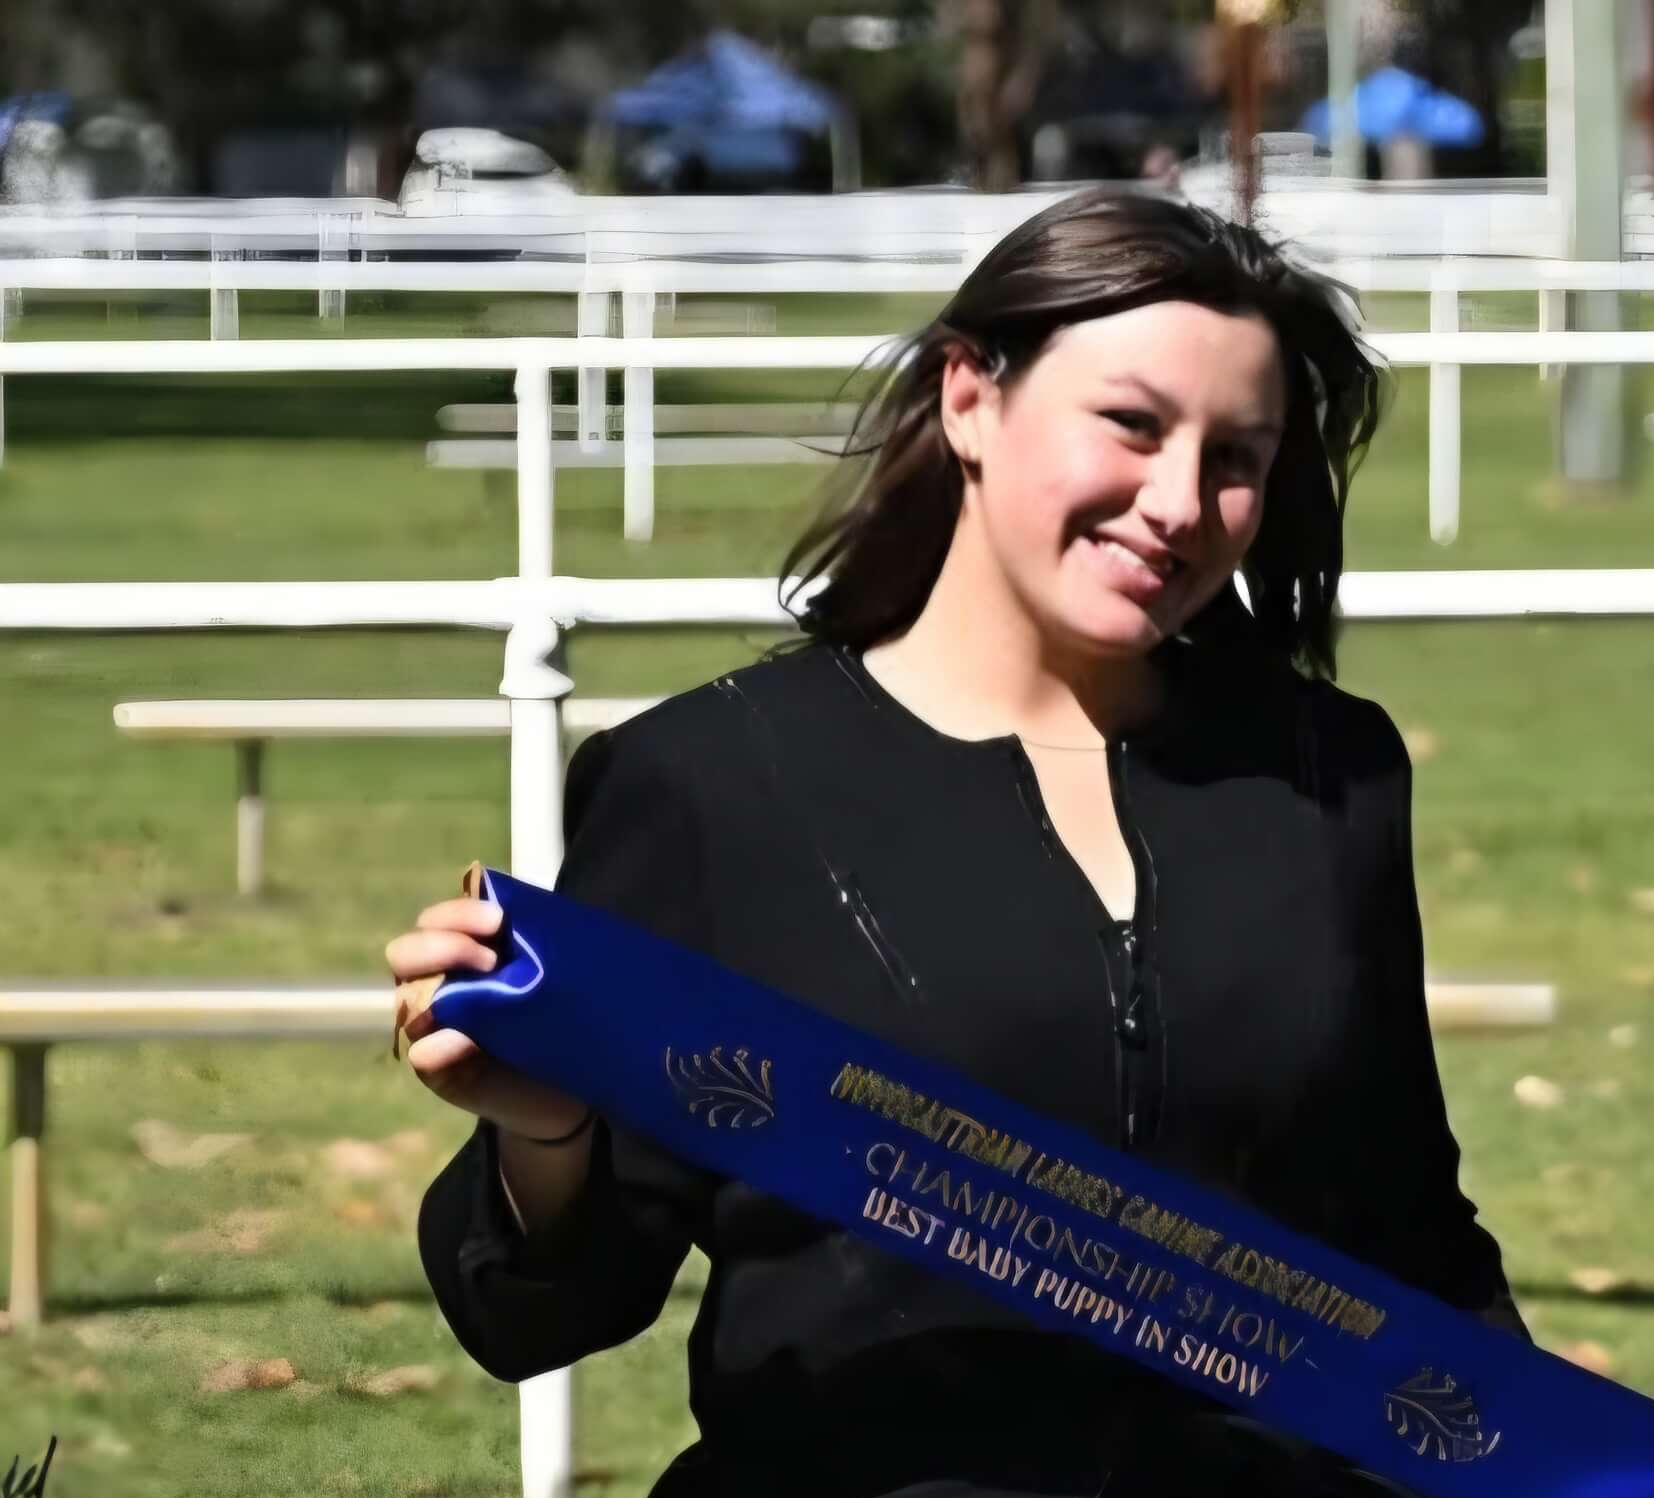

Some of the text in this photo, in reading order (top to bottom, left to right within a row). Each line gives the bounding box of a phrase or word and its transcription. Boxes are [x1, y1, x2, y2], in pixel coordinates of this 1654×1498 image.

[862, 1186, 946, 1246] BEST
[1033, 1267, 1135, 1336] PUPPY
[1135, 1315, 1172, 1353] IN
[1173, 1334, 1270, 1397] SHOW
